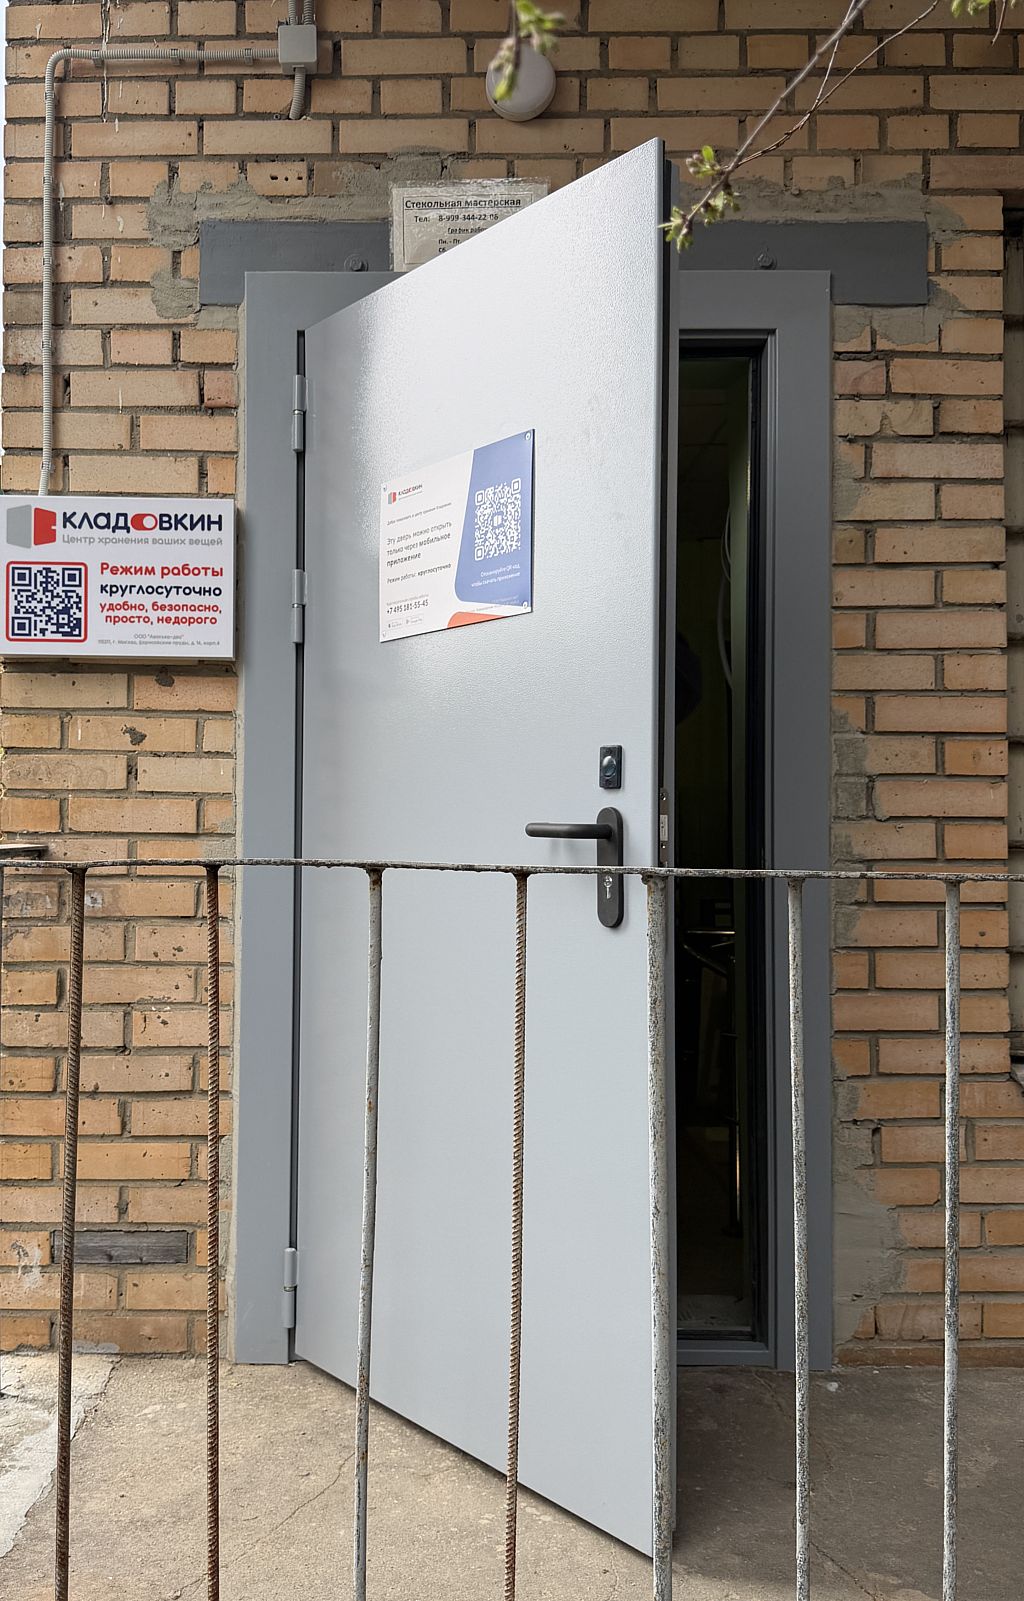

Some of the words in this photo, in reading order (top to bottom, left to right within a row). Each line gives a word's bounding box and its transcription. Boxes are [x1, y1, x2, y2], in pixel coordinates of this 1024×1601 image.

[405, 199, 462, 208] Стекольная
[465, 198, 521, 207] мастерская
[397, 533, 411, 543] дверь
[413, 528, 429, 538] можно
[430, 522, 452, 532] открыть
[62, 534, 94, 545] Центр
[98, 536, 149, 546] хранения
[189, 537, 223, 546] вещей
[387, 546, 403, 556] только
[404, 542, 418, 551] через
[419, 533, 451, 547] мобильное
[387, 552, 421, 567] приложение
[100, 562, 156, 575] Режим
[160, 564, 223, 579] работы
[417, 563, 451, 577] круглосуточно
[100, 584, 222, 598] круглосуточно
[100, 601, 148, 613] удобно,
[152, 601, 222, 614] безопасно,
[105, 615, 153, 625] просто,
[157, 616, 217, 626] недорого
